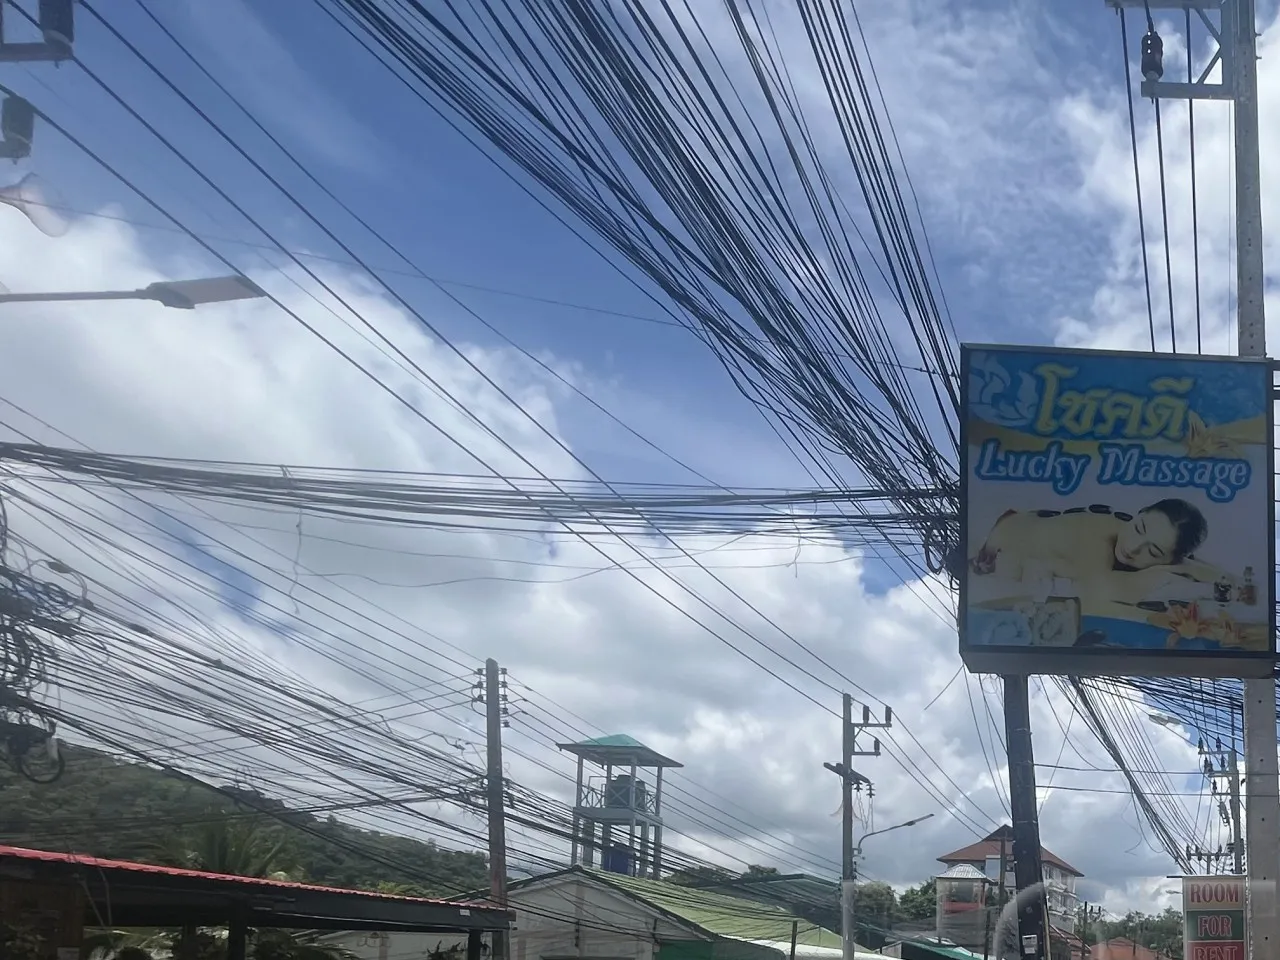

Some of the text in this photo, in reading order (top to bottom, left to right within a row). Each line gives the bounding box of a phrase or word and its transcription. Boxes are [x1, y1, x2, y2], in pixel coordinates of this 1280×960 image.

[1034, 362, 1194, 440] โชคดี
[979, 440, 1249, 502] Lucky Massage
[1190, 883, 1239, 903] ROOM
[1197, 915, 1232, 938] FOR
